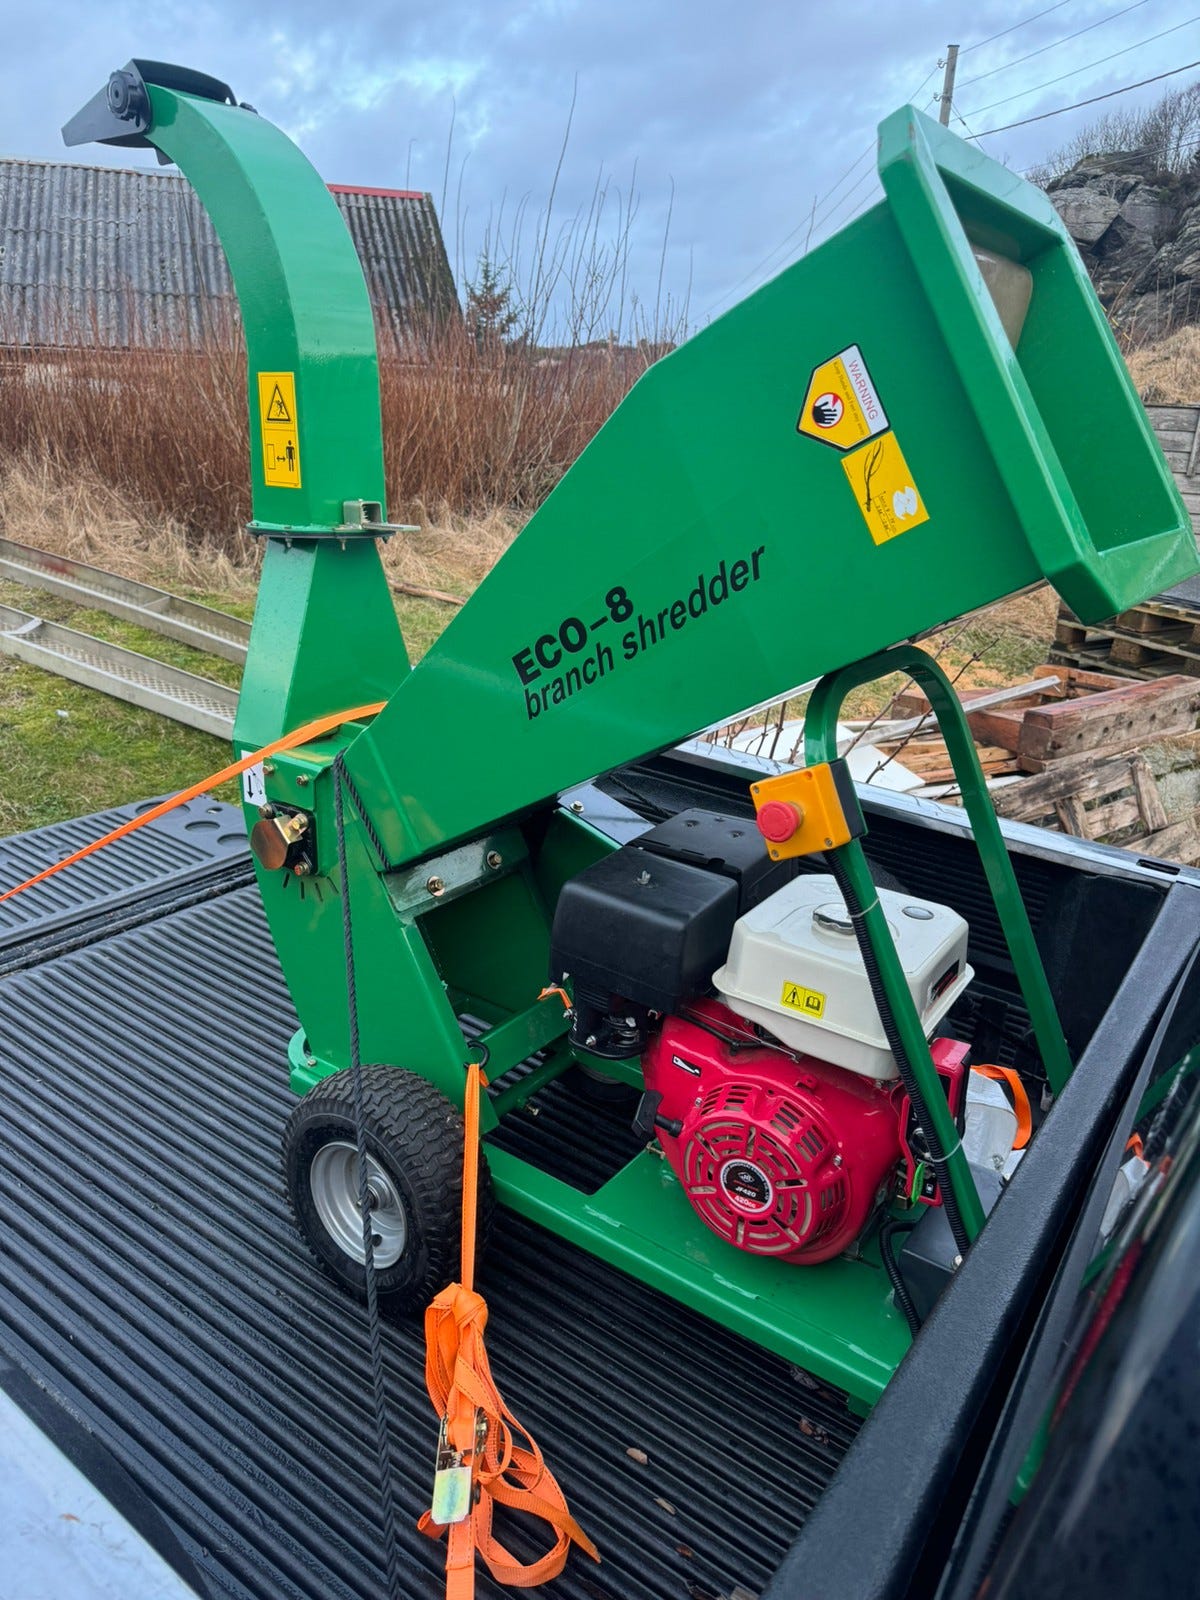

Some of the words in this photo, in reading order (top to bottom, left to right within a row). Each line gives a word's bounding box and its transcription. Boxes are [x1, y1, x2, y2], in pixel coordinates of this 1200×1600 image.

[848, 360, 879, 420] WARNING
[511, 586, 634, 686] ECO-8
[524, 642, 614, 720] branch
[622, 545, 765, 660] shredder
